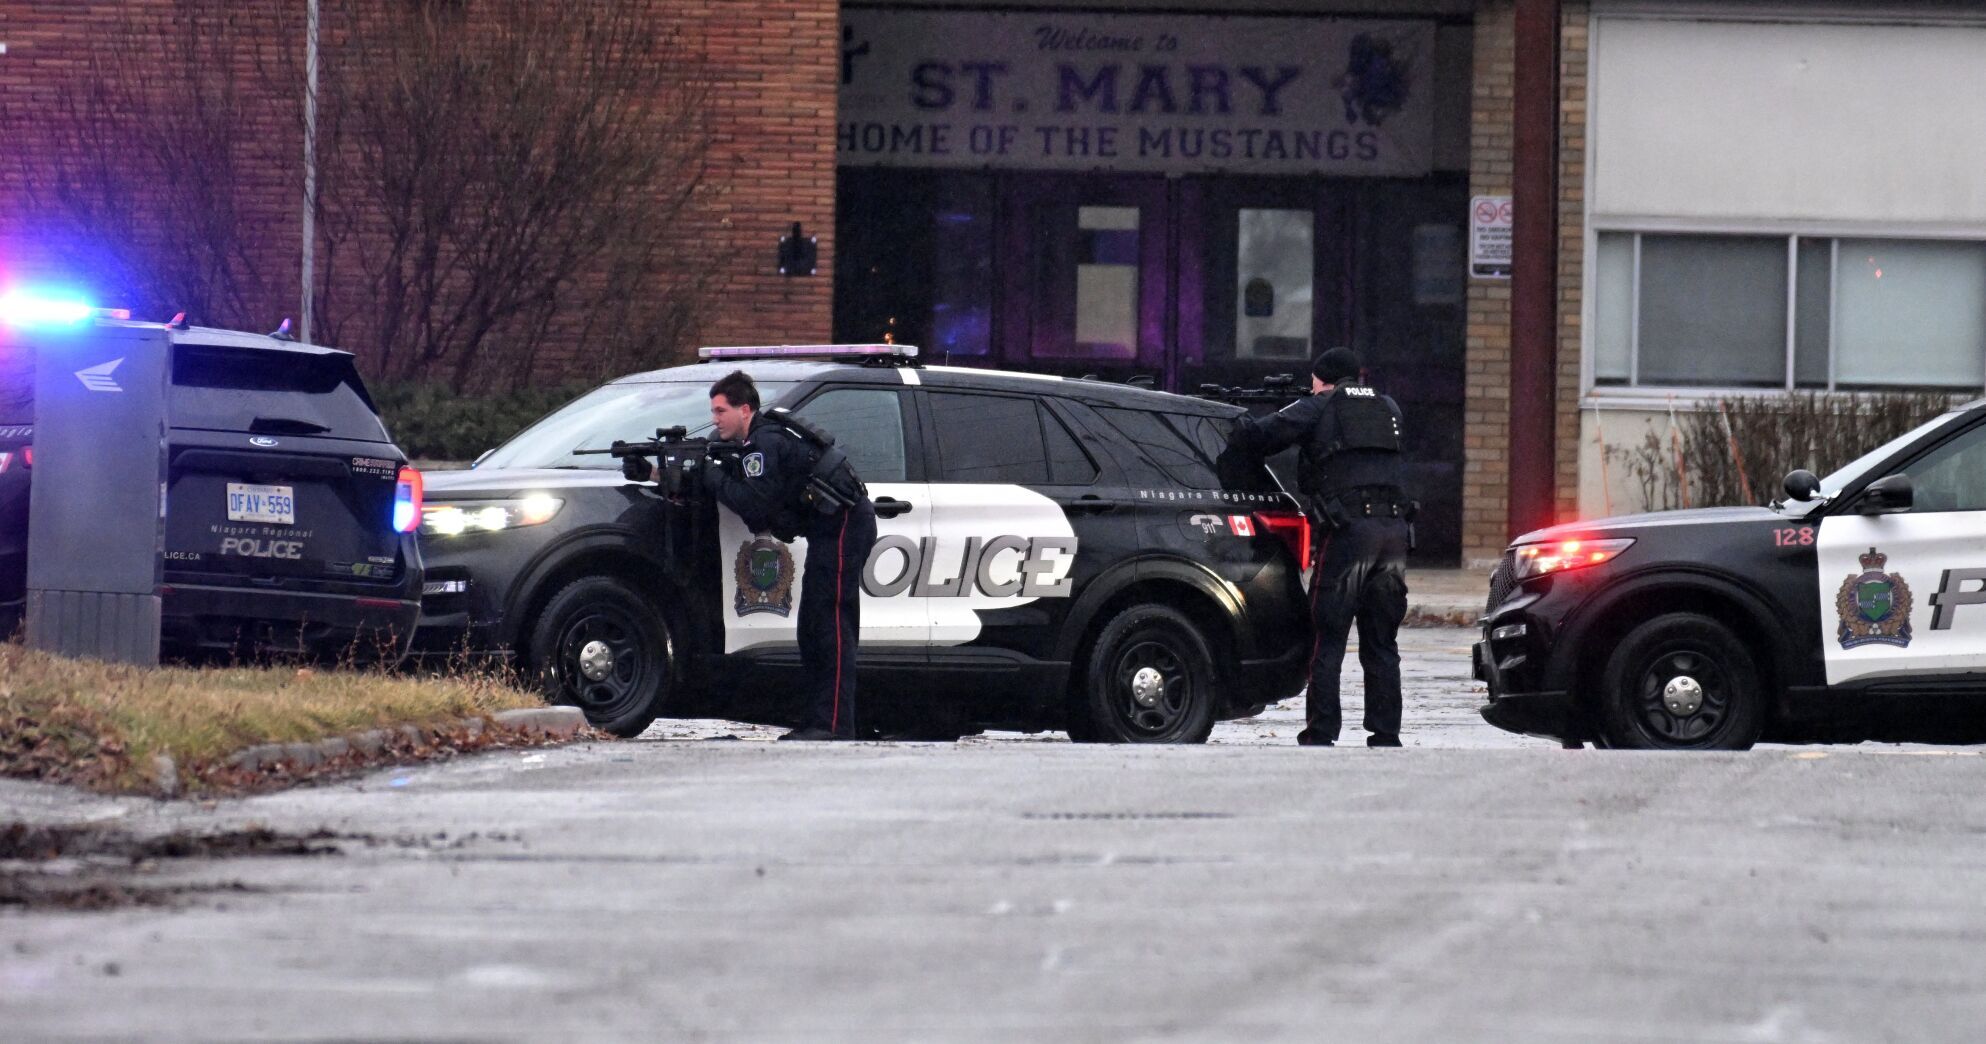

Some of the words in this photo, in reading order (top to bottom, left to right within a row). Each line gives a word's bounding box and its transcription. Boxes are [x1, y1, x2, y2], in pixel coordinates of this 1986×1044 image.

[1034, 27, 1143, 51] Welcome
[1156, 33, 1178, 50] to
[911, 60, 1029, 112] ST.
[1056, 63, 1299, 116] MARY
[837, 122, 952, 154] HOME
[968, 124, 1019, 155] OF
[1034, 126, 1119, 157] THE
[1138, 127, 1379, 161] MUSTANGS
[1345, 387, 1376, 397] POLICE
[230, 493, 260, 512] DFAY
[268, 495, 291, 514] 559
[1140, 490, 1203, 501] Niagara
[1212, 490, 1280, 503] Regional
[210, 524, 257, 536] Niagara
[262, 526, 313, 538] Regional
[1201, 522, 1217, 534] 911
[1772, 526, 1815, 546] 128
[164, 551, 201, 561] LICE.CA
[220, 537, 304, 560] POLICE
[859, 534, 1079, 598] OLICE
